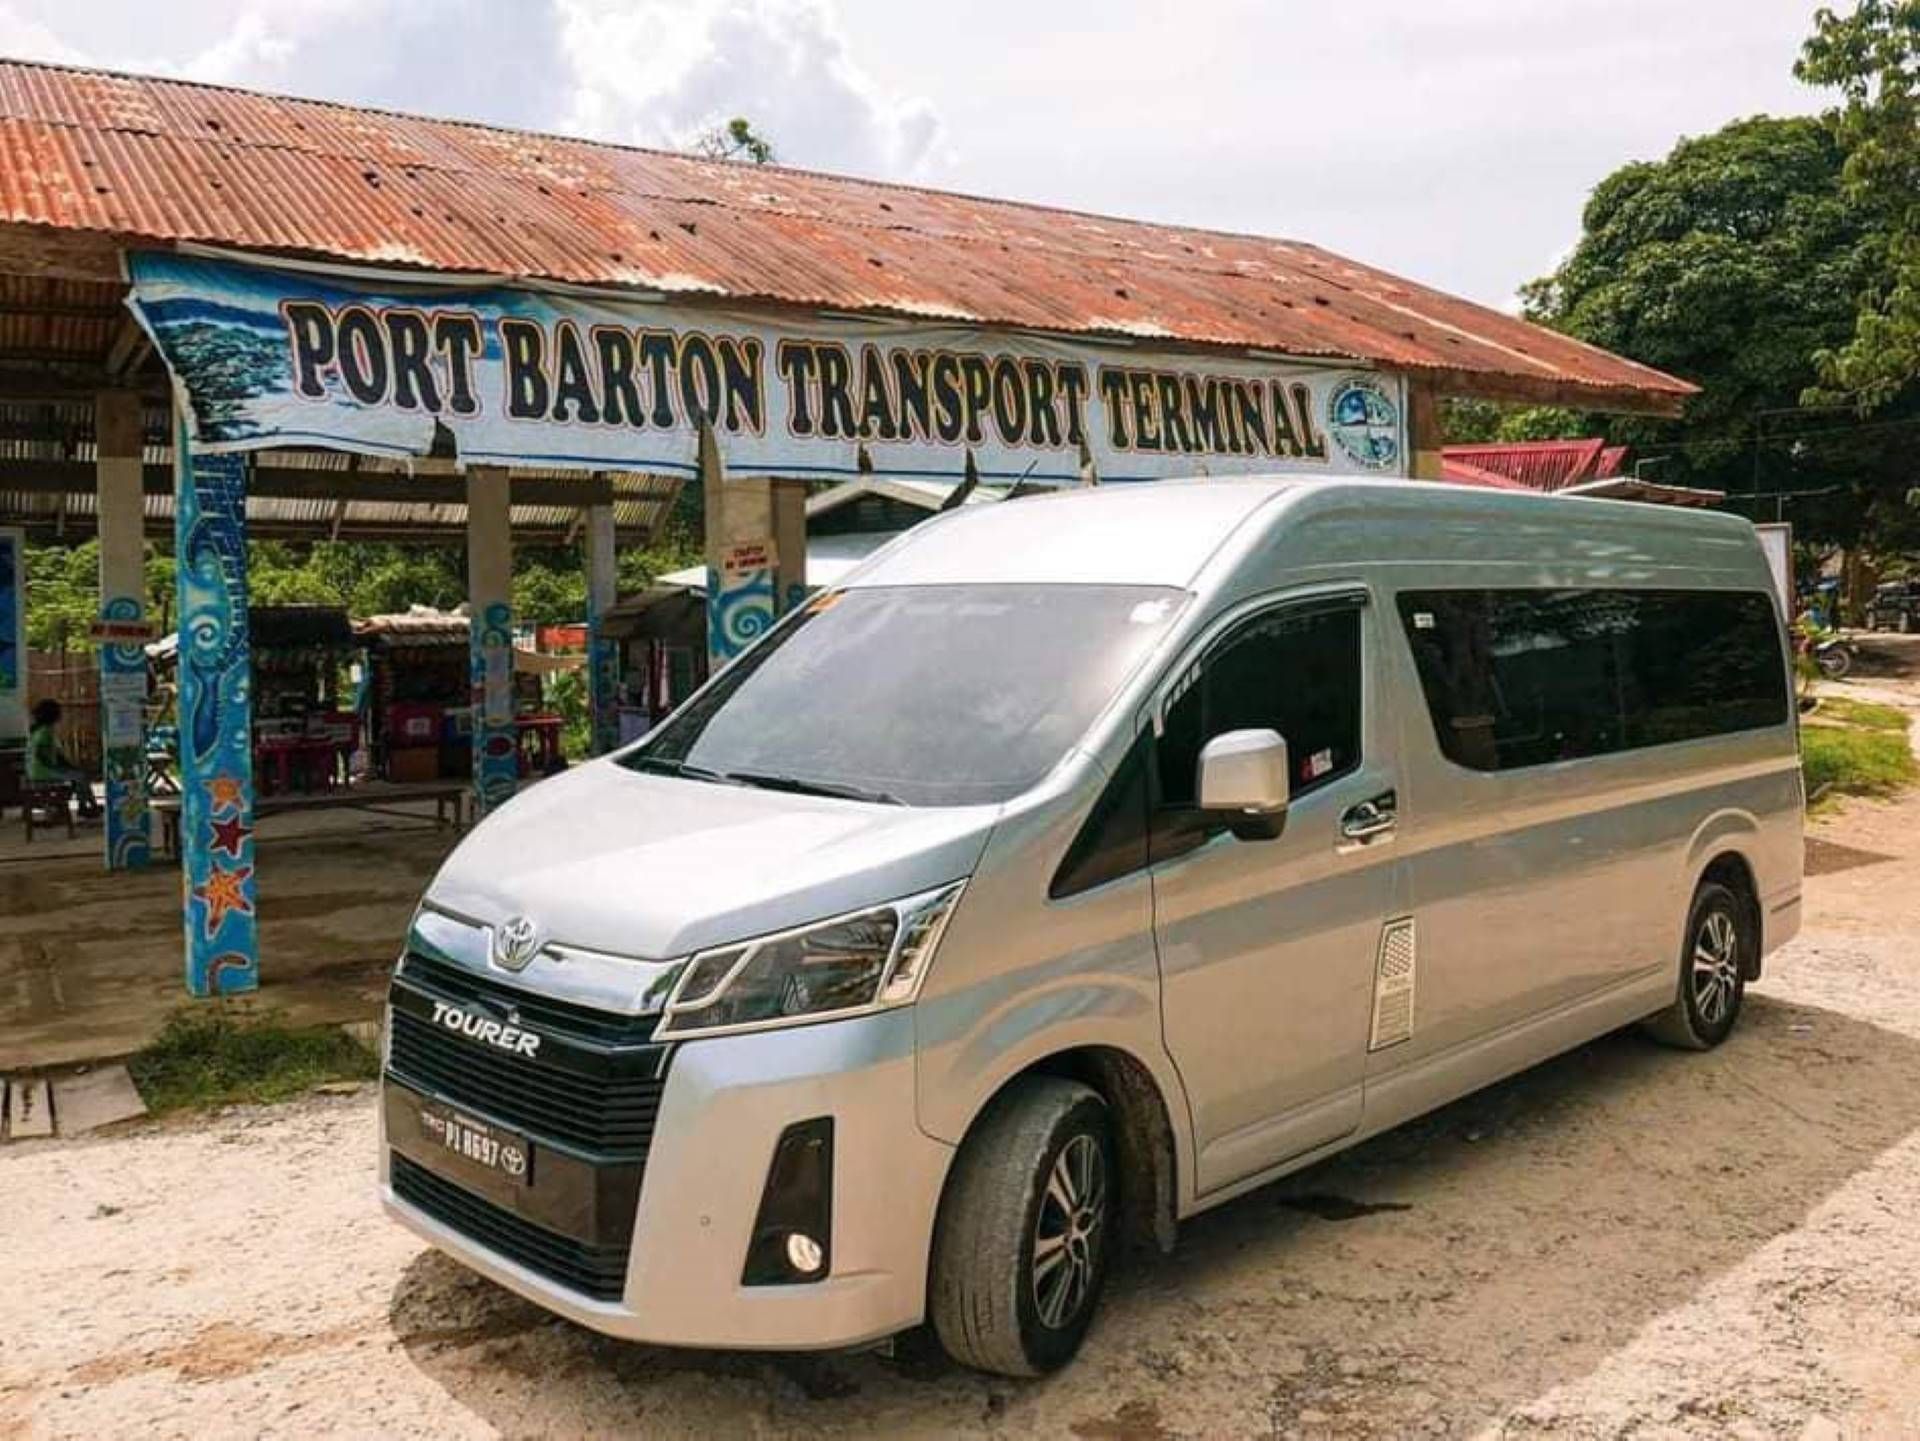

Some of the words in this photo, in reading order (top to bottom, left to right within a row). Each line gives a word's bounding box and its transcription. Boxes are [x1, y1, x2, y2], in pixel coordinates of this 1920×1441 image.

[281, 300, 482, 417] PORT
[500, 316, 766, 436] BARTON
[777, 339, 1092, 450] TRANSPORT
[1101, 365, 1330, 463] TERMINAL
[432, 1002, 541, 1057] TOURER
